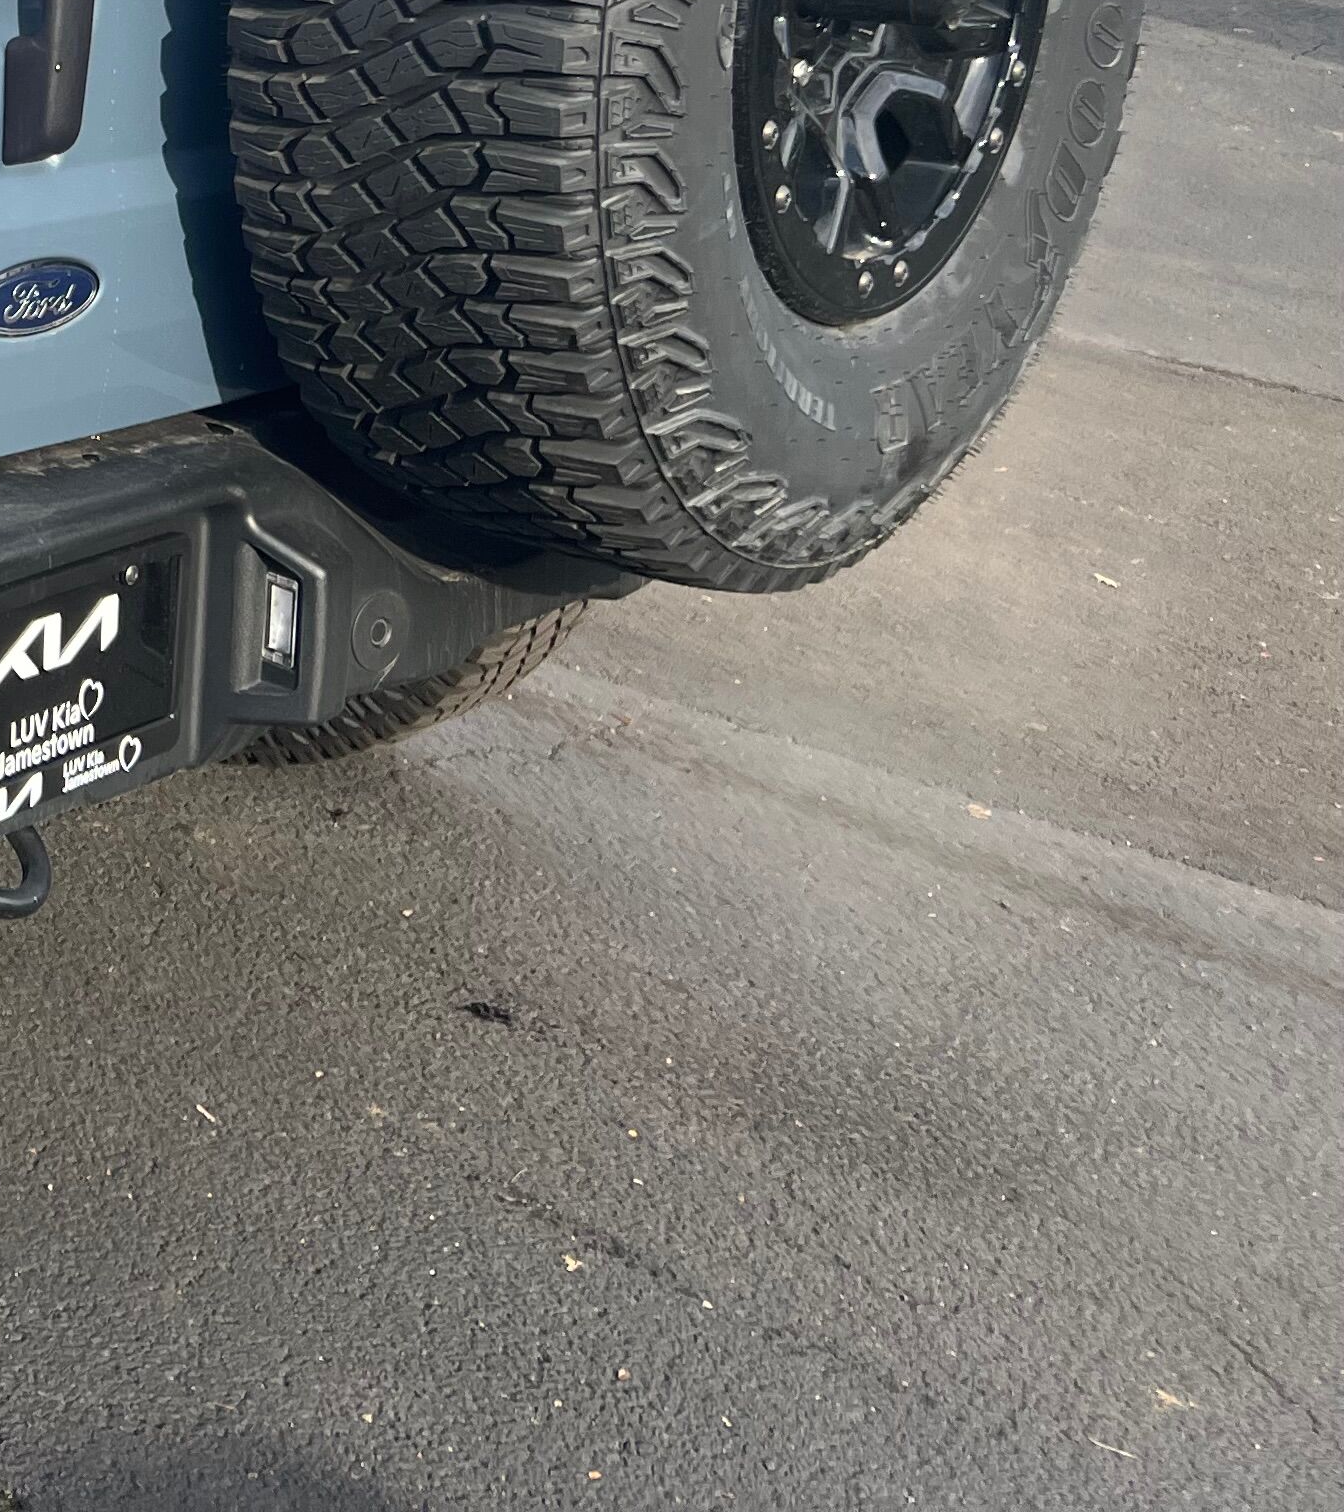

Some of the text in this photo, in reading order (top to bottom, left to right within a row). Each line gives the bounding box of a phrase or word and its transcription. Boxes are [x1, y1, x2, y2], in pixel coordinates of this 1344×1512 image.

[3, 278, 76, 324] Ford
[11, 700, 81, 748] LUV Kia
[61, 758, 120, 794] Jamestown
[62, 754, 86, 778] LUV
